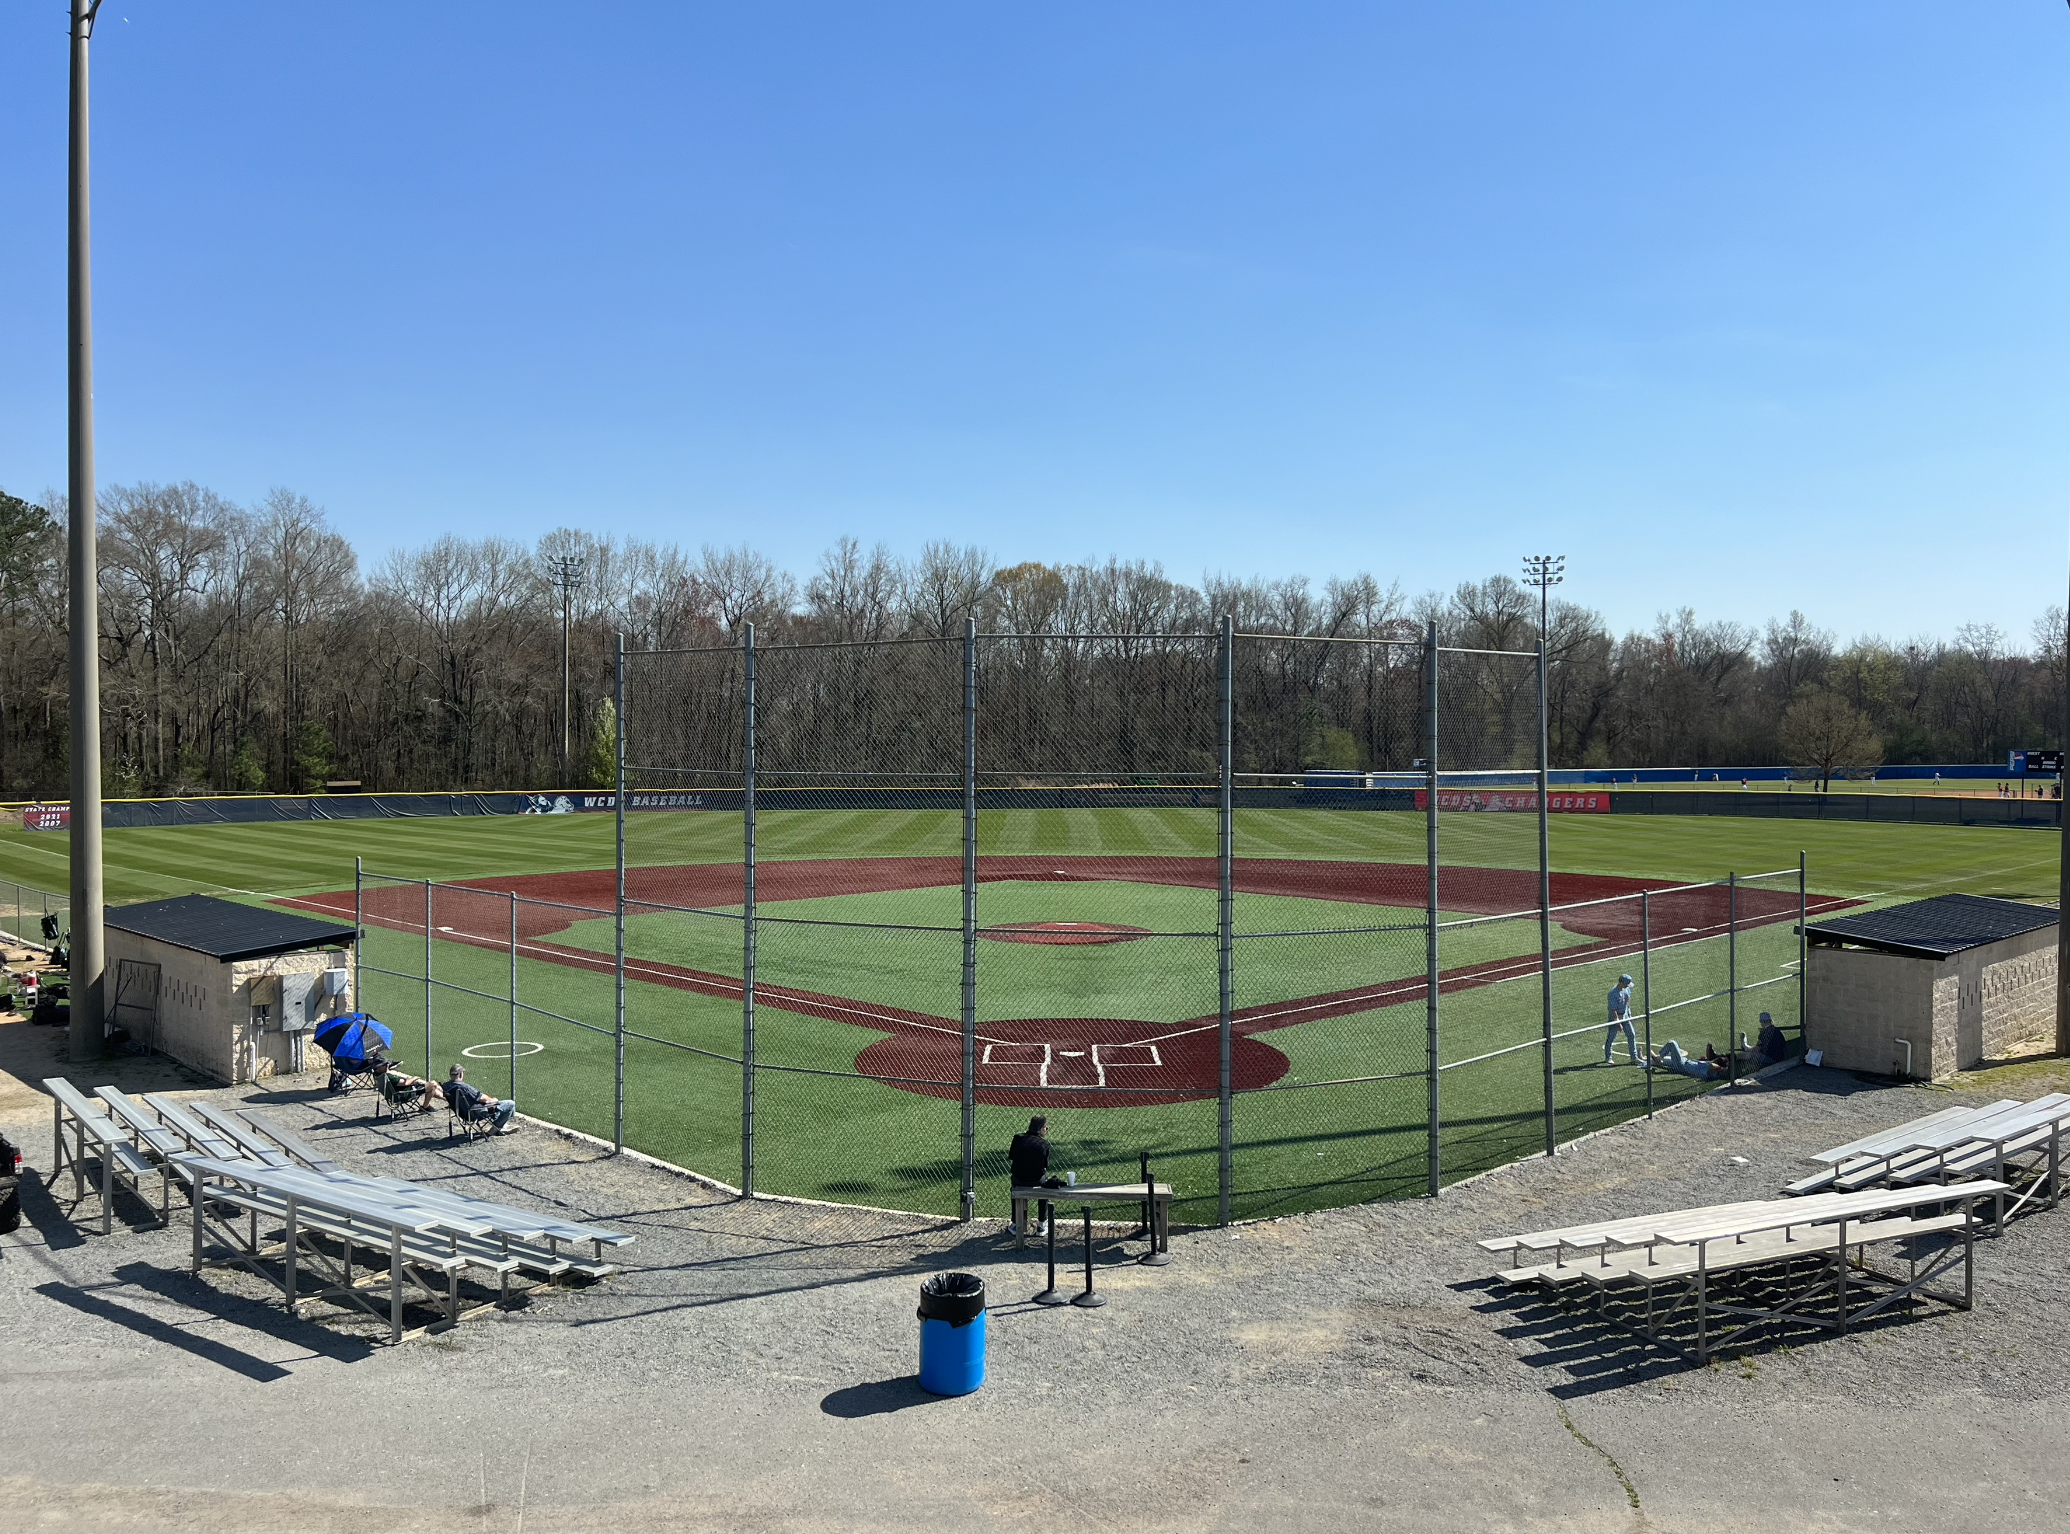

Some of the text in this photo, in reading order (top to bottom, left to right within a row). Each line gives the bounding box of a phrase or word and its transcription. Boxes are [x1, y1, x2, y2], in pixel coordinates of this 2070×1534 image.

[584, 796, 702, 807] WCD BASEBALL
[1505, 797, 1598, 808] CHAGERS
